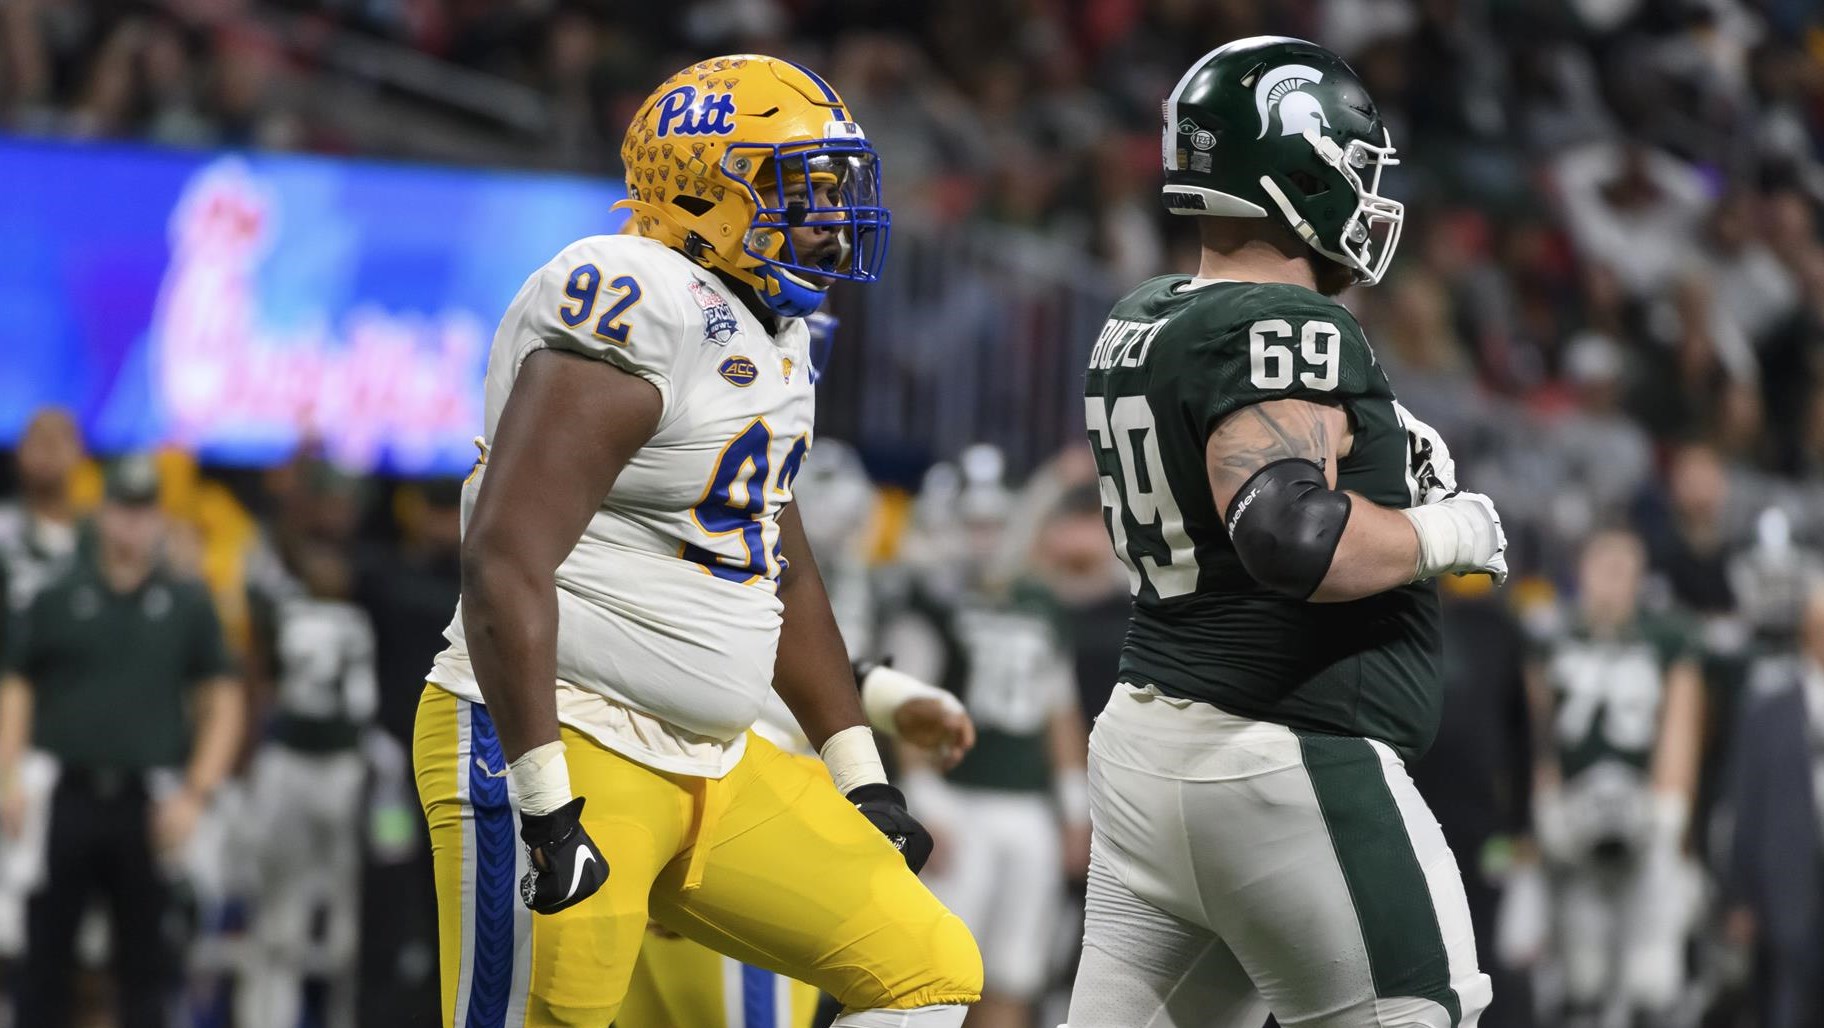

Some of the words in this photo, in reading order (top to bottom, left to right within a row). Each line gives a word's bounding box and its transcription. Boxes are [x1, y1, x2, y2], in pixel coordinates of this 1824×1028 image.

[656, 86, 737, 138] Pitt
[558, 262, 643, 347] 92
[703, 304, 735, 327] PEACH
[725, 362, 754, 375] ACC
[1250, 319, 1341, 391] 69
